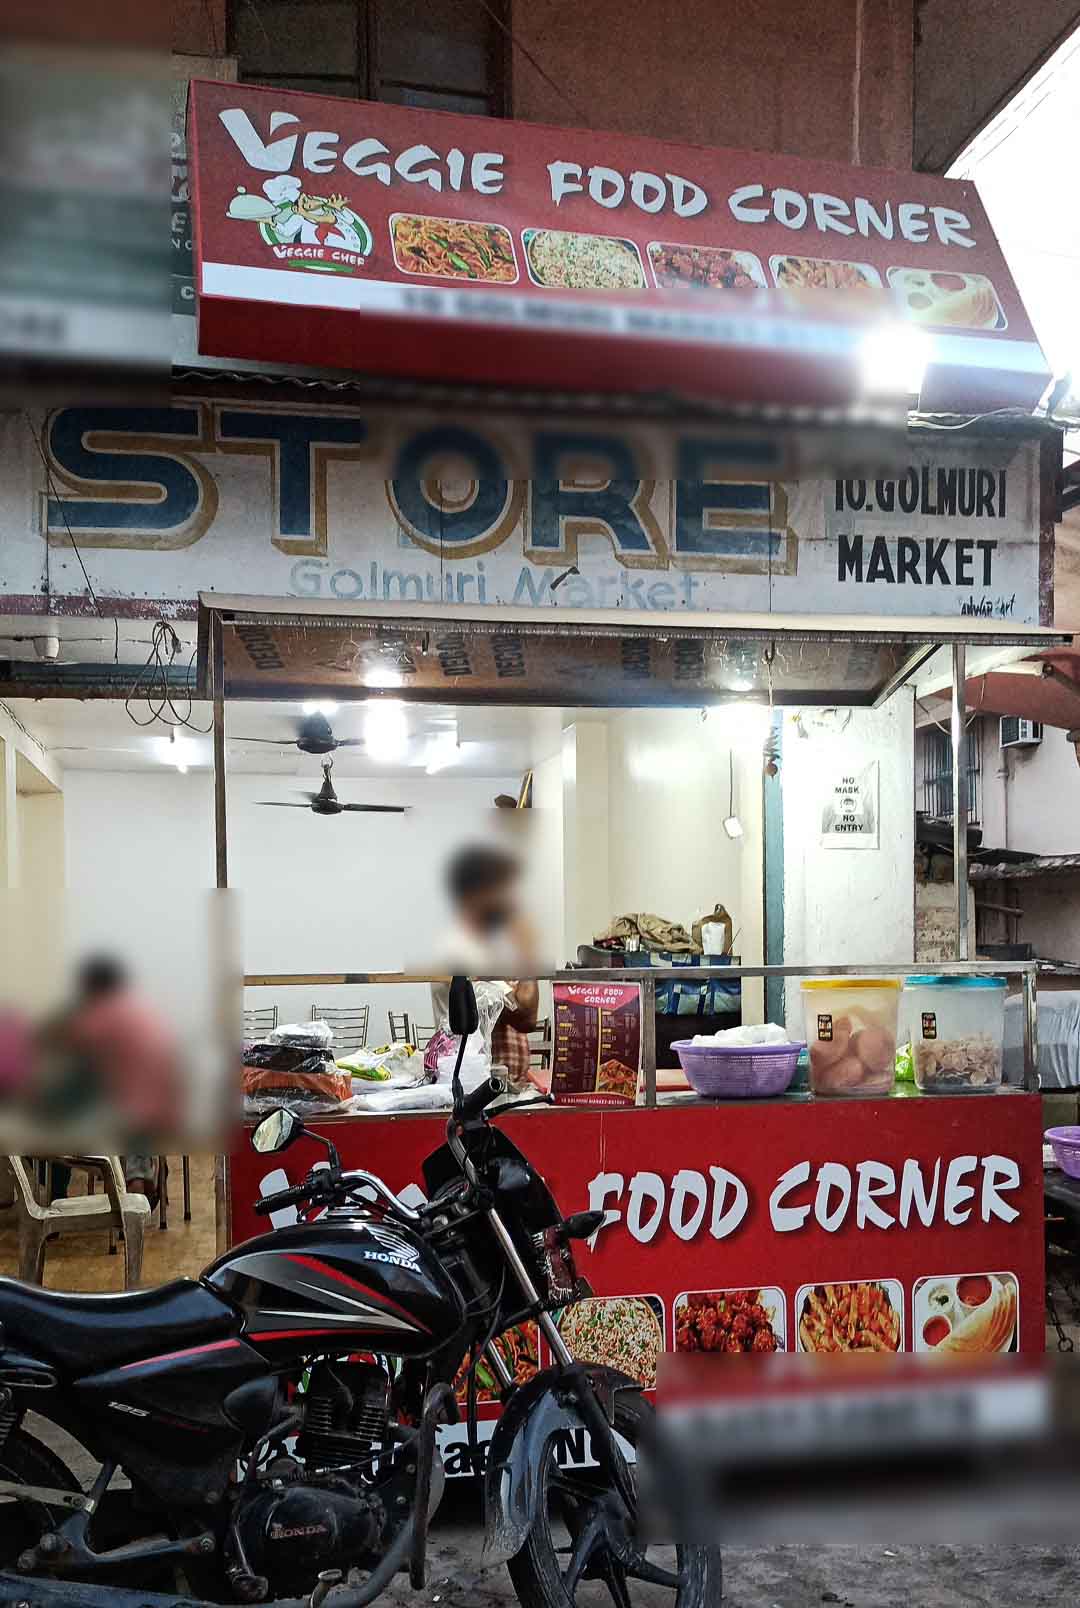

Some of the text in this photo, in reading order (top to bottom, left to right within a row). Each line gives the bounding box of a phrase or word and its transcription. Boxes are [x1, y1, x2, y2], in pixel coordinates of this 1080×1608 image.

[219, 108, 504, 195] VEGGIE
[546, 160, 709, 218] FOOD
[727, 184, 977, 248] CORNER
[272, 245, 325, 259] VEGGIE
[40, 401, 797, 577] STORE
[838, 535, 998, 586] MARKET
[289, 559, 488, 601] Golmuri
[512, 565, 700, 611] Market
[834, 786, 860, 795] MASK
[842, 776, 855, 785] NO
[834, 823, 864, 832] ENTRY
[842, 814, 856, 822] NO
[584, 996, 616, 1005] CORNER
[586, 1154, 1020, 1253] FOOD CORNER
[363, 1250, 422, 1273] HONDA
